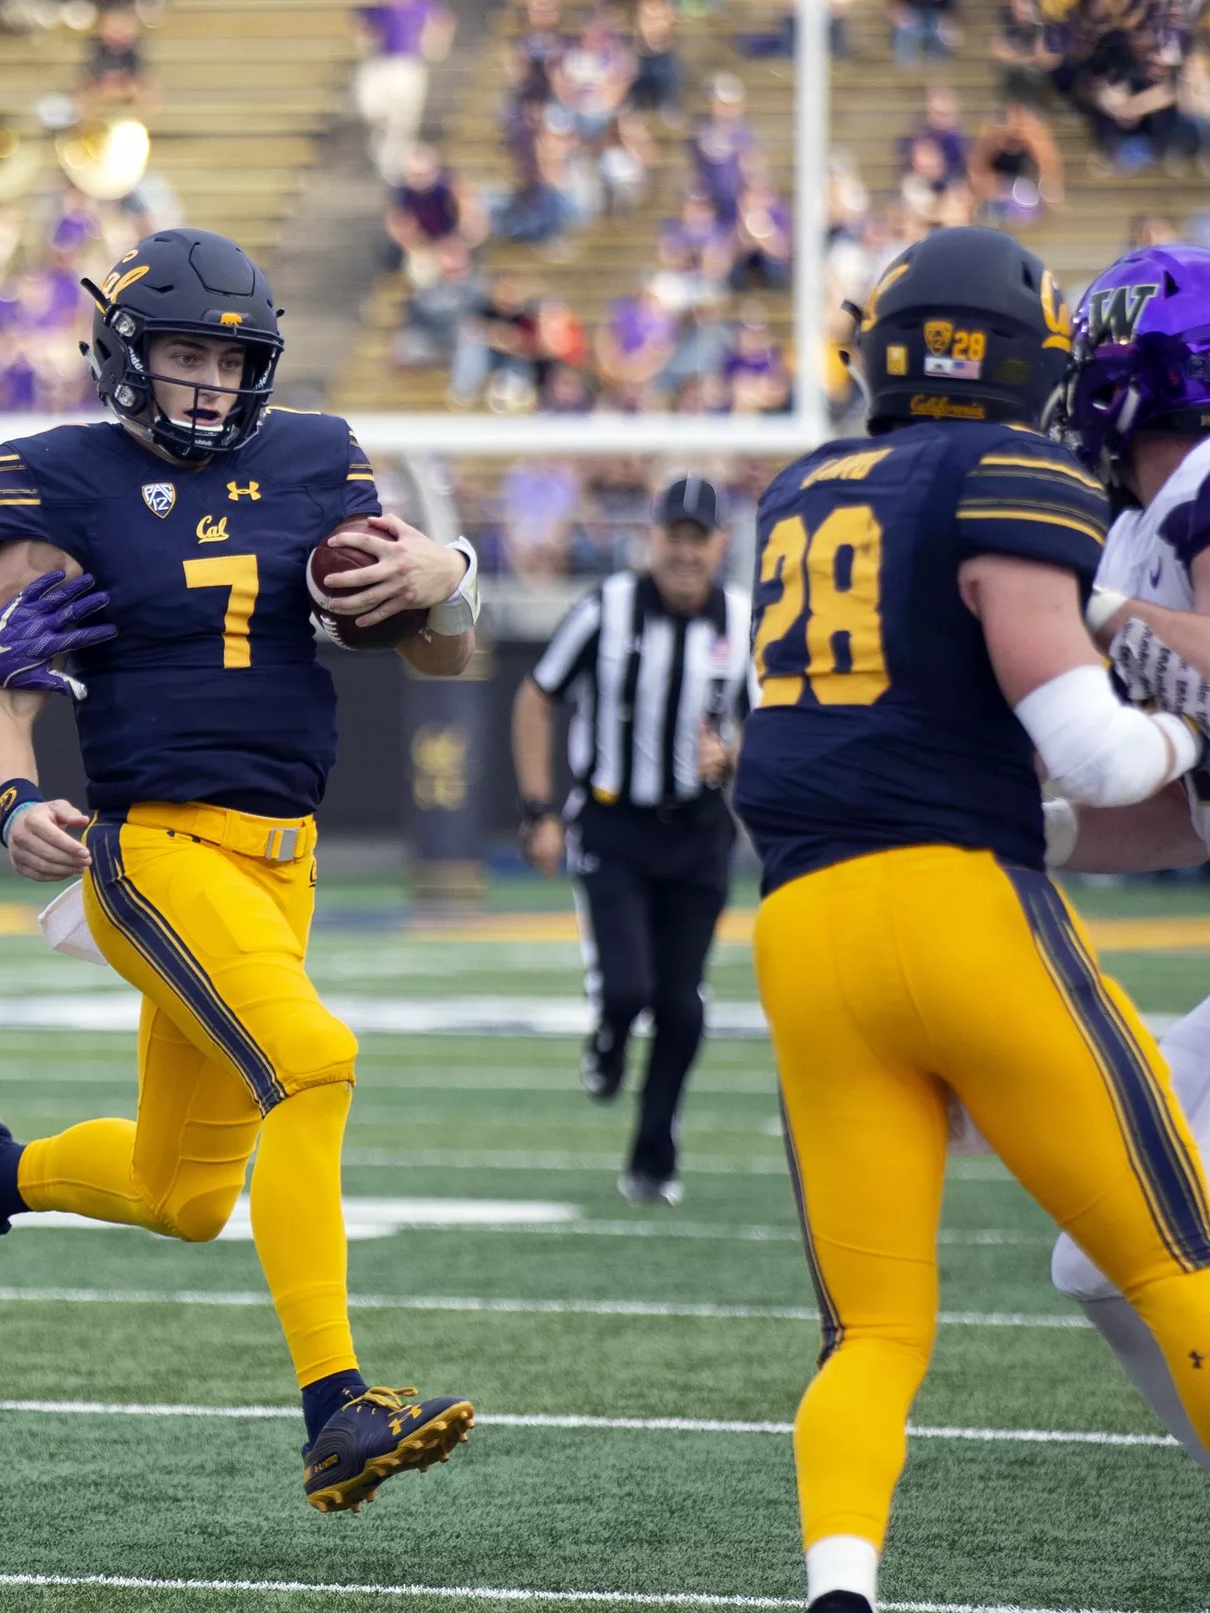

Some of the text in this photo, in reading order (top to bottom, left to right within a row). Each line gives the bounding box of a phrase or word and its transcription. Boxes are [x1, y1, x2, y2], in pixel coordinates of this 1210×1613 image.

[1088, 284, 1159, 345] W
[952, 331, 986, 360] 28
[145, 484, 173, 506] PAC
[153, 496, 169, 512] 12
[196, 514, 230, 545] Cal
[182, 554, 259, 670] 7
[753, 504, 891, 708] 28
